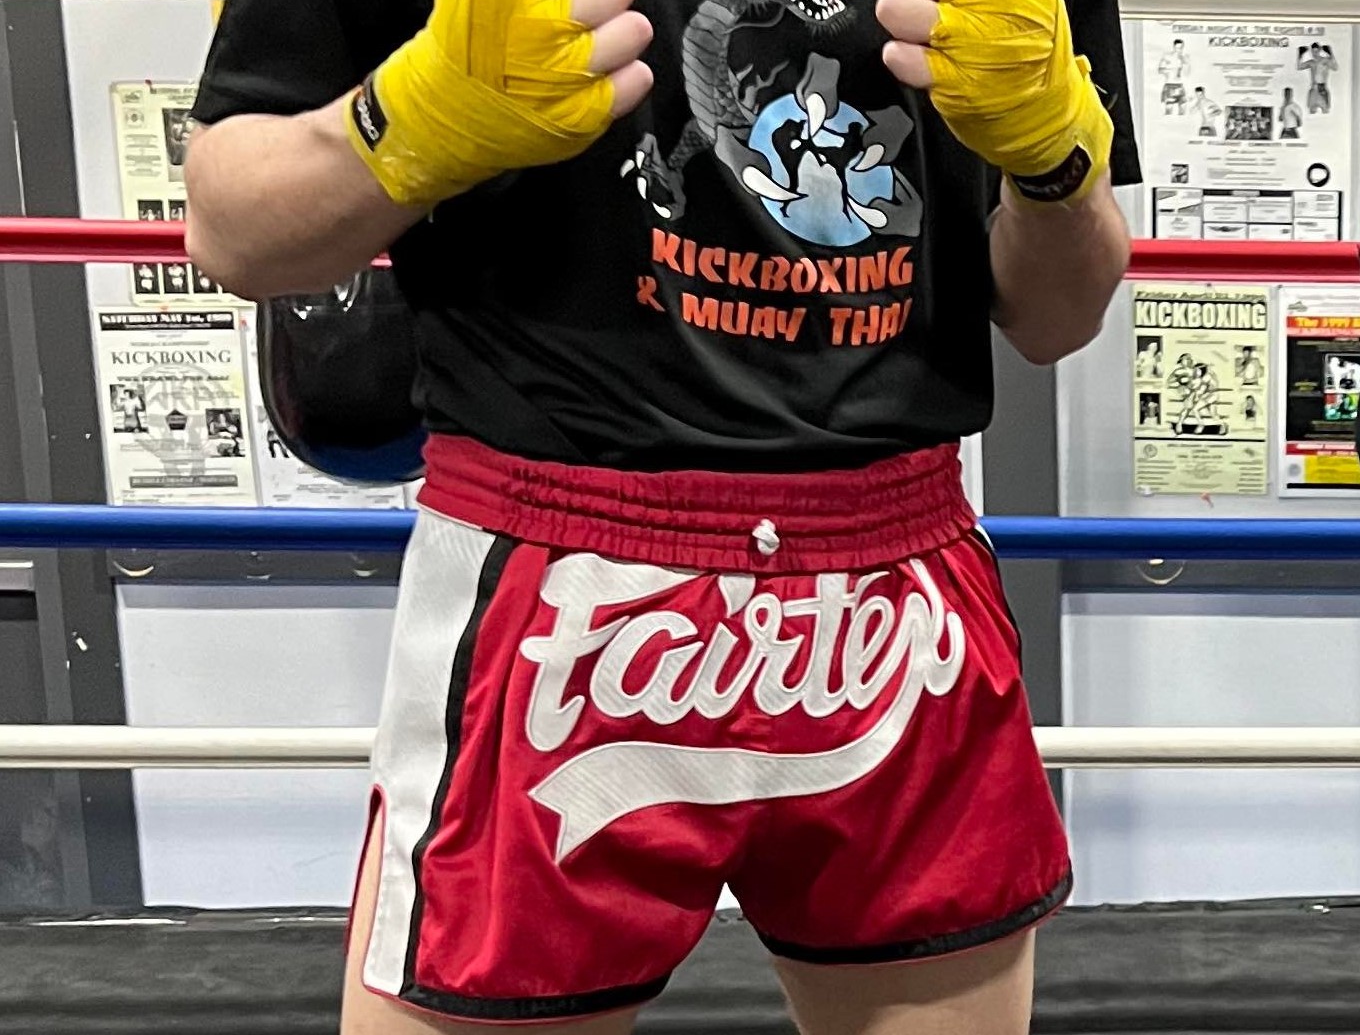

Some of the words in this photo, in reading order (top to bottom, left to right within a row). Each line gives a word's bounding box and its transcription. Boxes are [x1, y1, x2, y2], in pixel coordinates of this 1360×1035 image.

[1208, 37, 1289, 48] KICKBOXING
[653, 228, 913, 293] KICKBOXING
[637, 276, 665, 312] &
[681, 292, 807, 343] MUAY
[830, 298, 913, 346] THAI
[1136, 300, 1266, 329] KICKBOXING
[111, 350, 231, 364] KICKBOXING
[519, 552, 967, 752] Fairtex
